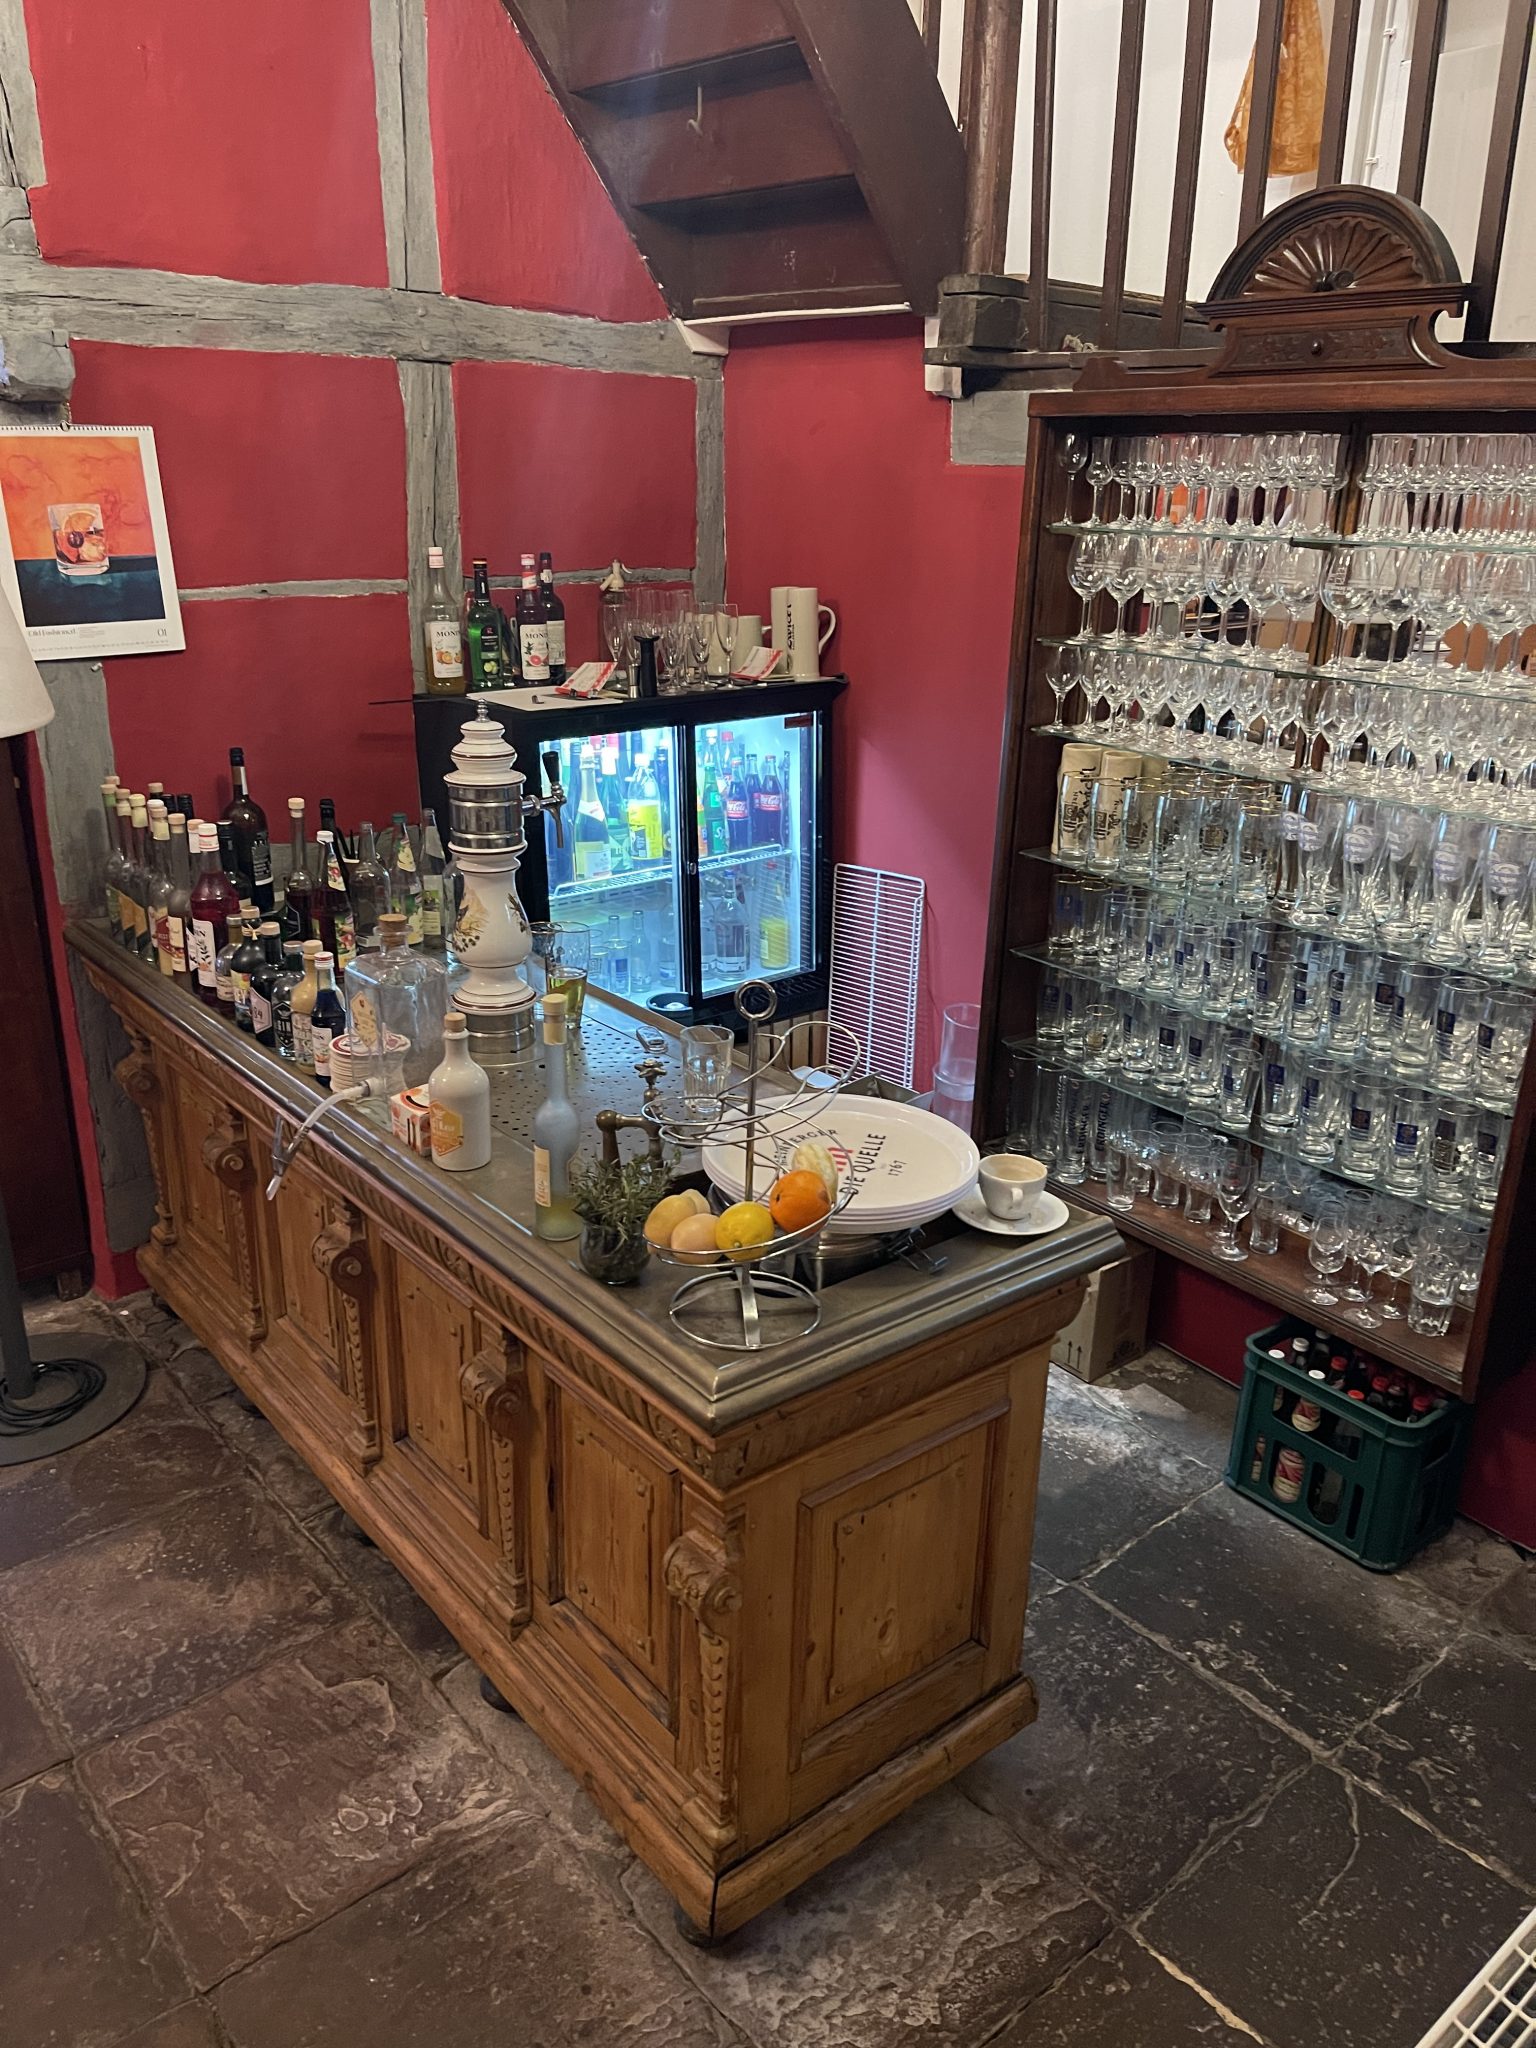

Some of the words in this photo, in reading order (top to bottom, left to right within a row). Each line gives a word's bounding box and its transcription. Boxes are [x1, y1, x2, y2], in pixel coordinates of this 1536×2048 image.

[839, 1175, 866, 1195] DIE
[854, 1133, 887, 1173] QUELLE
[888, 1160, 908, 1177] 1767
